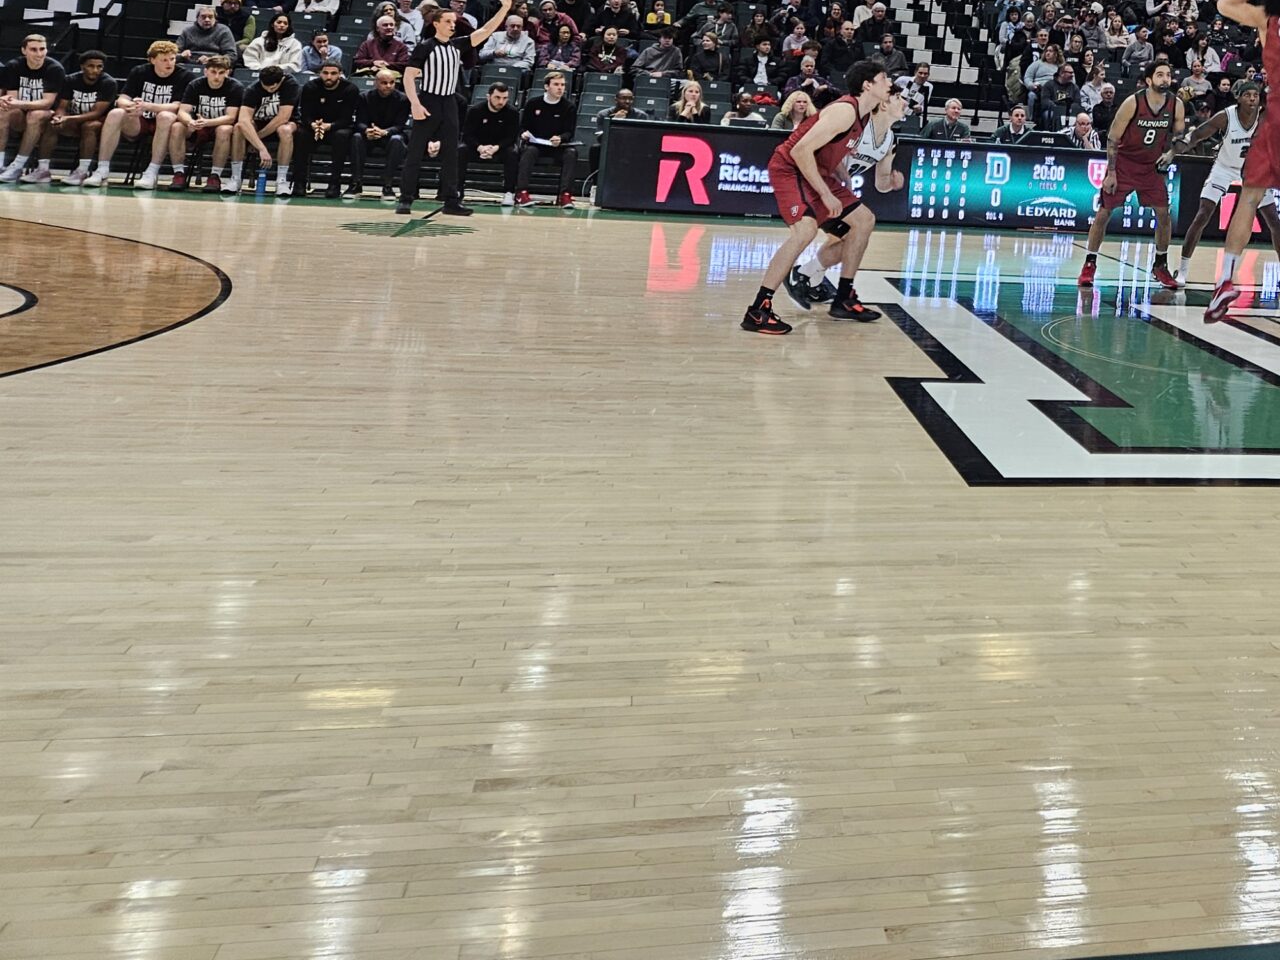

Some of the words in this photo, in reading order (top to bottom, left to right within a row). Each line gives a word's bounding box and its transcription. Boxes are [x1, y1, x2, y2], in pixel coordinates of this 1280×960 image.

[143, 82, 155, 94] THIS
[155, 85, 174, 96] GAME
[1138, 120, 1168, 128] HARVARD
[1144, 130, 1156, 144] 8
[718, 152, 741, 164] The
[655, 136, 713, 205] R
[719, 164, 770, 184] Richa
[985, 152, 1011, 184] D
[1033, 164, 1065, 181] 20:00
[718, 182, 760, 193] FINANCIAL,
[991, 188, 1001, 207] 0
[1017, 206, 1076, 218] LEDYARD
[1054, 218, 1076, 227] BANK
